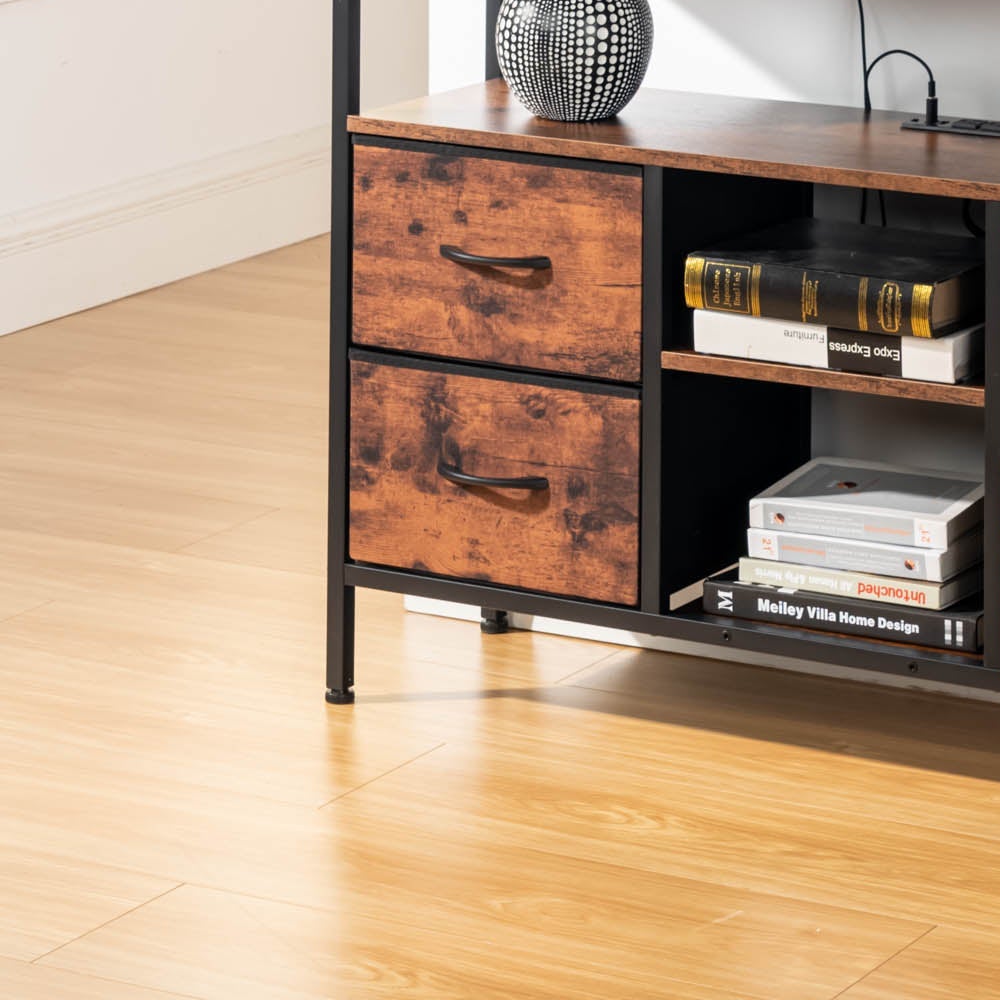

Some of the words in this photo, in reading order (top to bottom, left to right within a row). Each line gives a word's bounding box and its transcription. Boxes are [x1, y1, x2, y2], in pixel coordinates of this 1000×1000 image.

[783, 329, 825, 344] Furniture
[828, 341, 871, 358] Express
[873, 345, 901, 362] Expo
[857, 582, 927, 605] Untouched
[757, 598, 804, 619] Meiley
[807, 606, 837, 623] Villa
[839, 611, 876, 628] Home
[878, 617, 920, 635] Design
